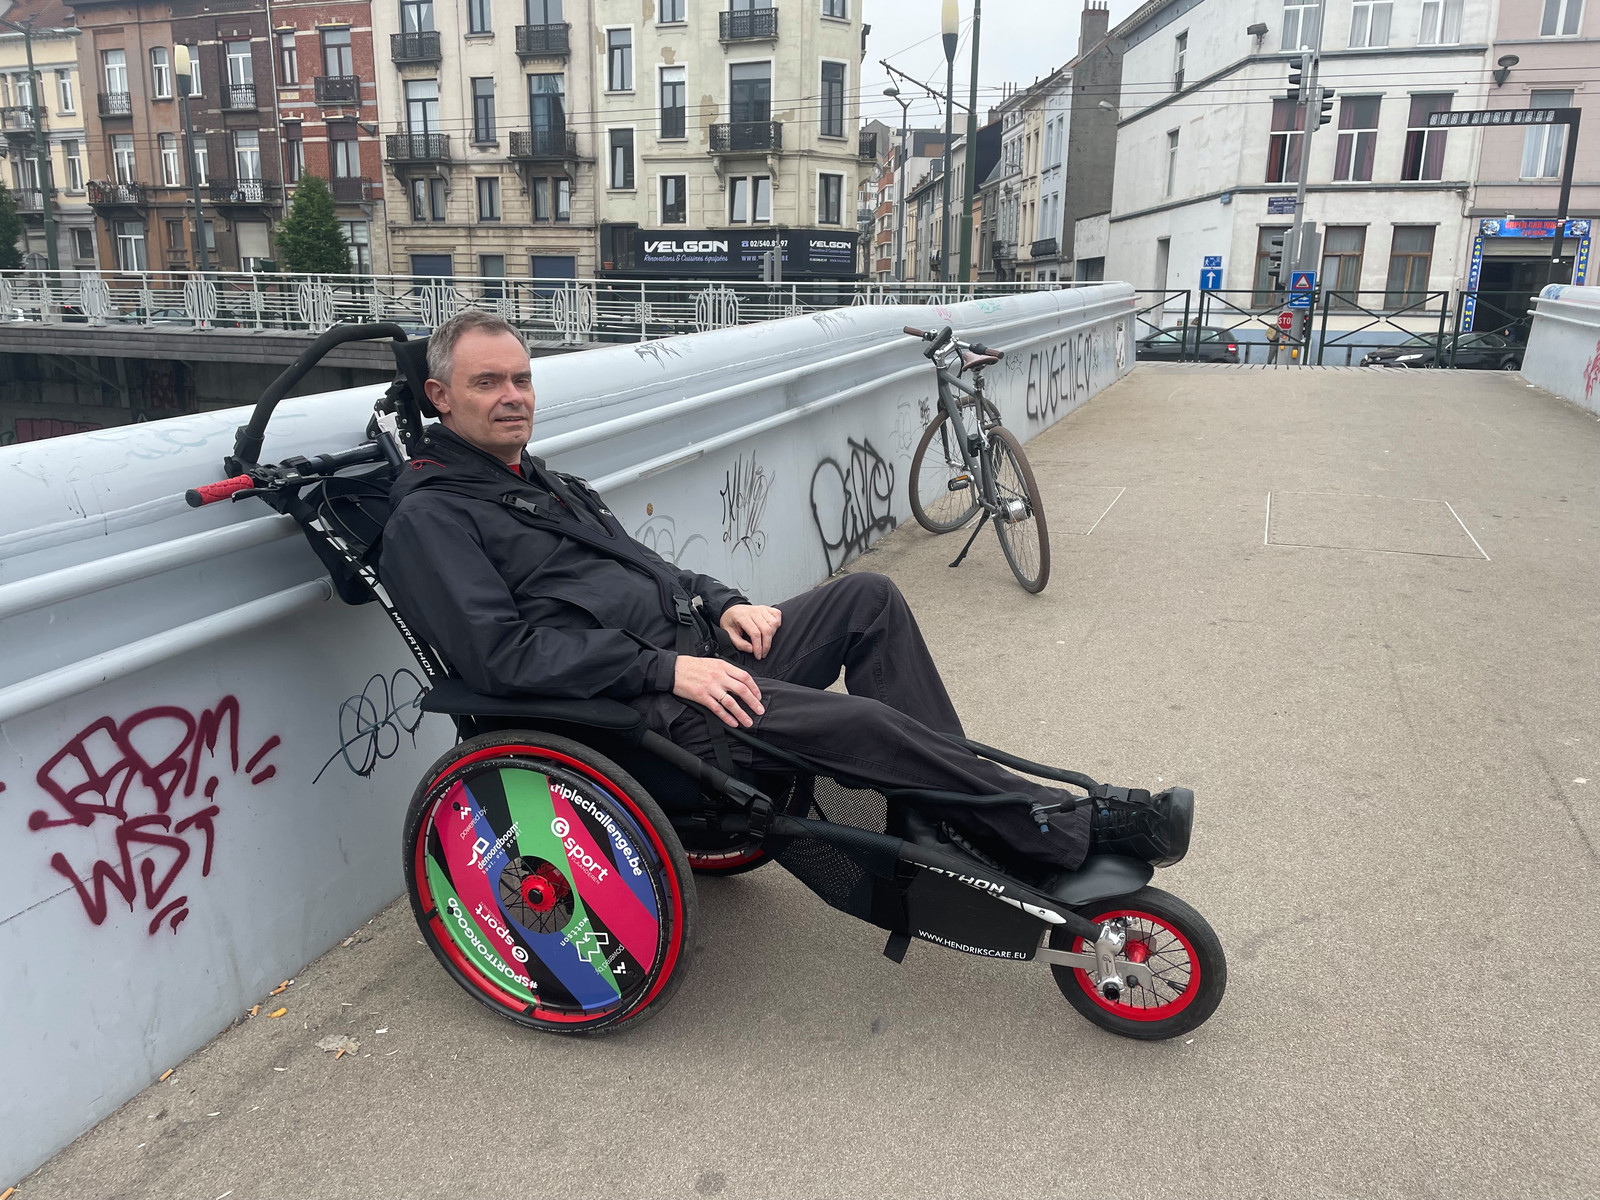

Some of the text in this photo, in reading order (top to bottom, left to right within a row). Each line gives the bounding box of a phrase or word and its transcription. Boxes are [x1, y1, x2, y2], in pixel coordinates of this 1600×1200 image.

[644, 240, 729, 253] VELGON
[809, 240, 851, 249] VELGON
[1578, 240, 1588, 277] SUPER
[1278, 317, 1291, 325] STO
[1026, 332, 1085, 421] EUGENE
[391, 611, 436, 677] MARATHON
[550, 783, 642, 877] triplechallenge.be
[563, 837, 608, 882] sport
[571, 856, 601, 885] VLAANDEREN
[447, 897, 538, 989] #SPORTFORGOOD
[474, 903, 515, 946] sport
[559, 916, 589, 947] wattson
[917, 928, 1028, 960] WWW.HENDRIKSCARE.EU
